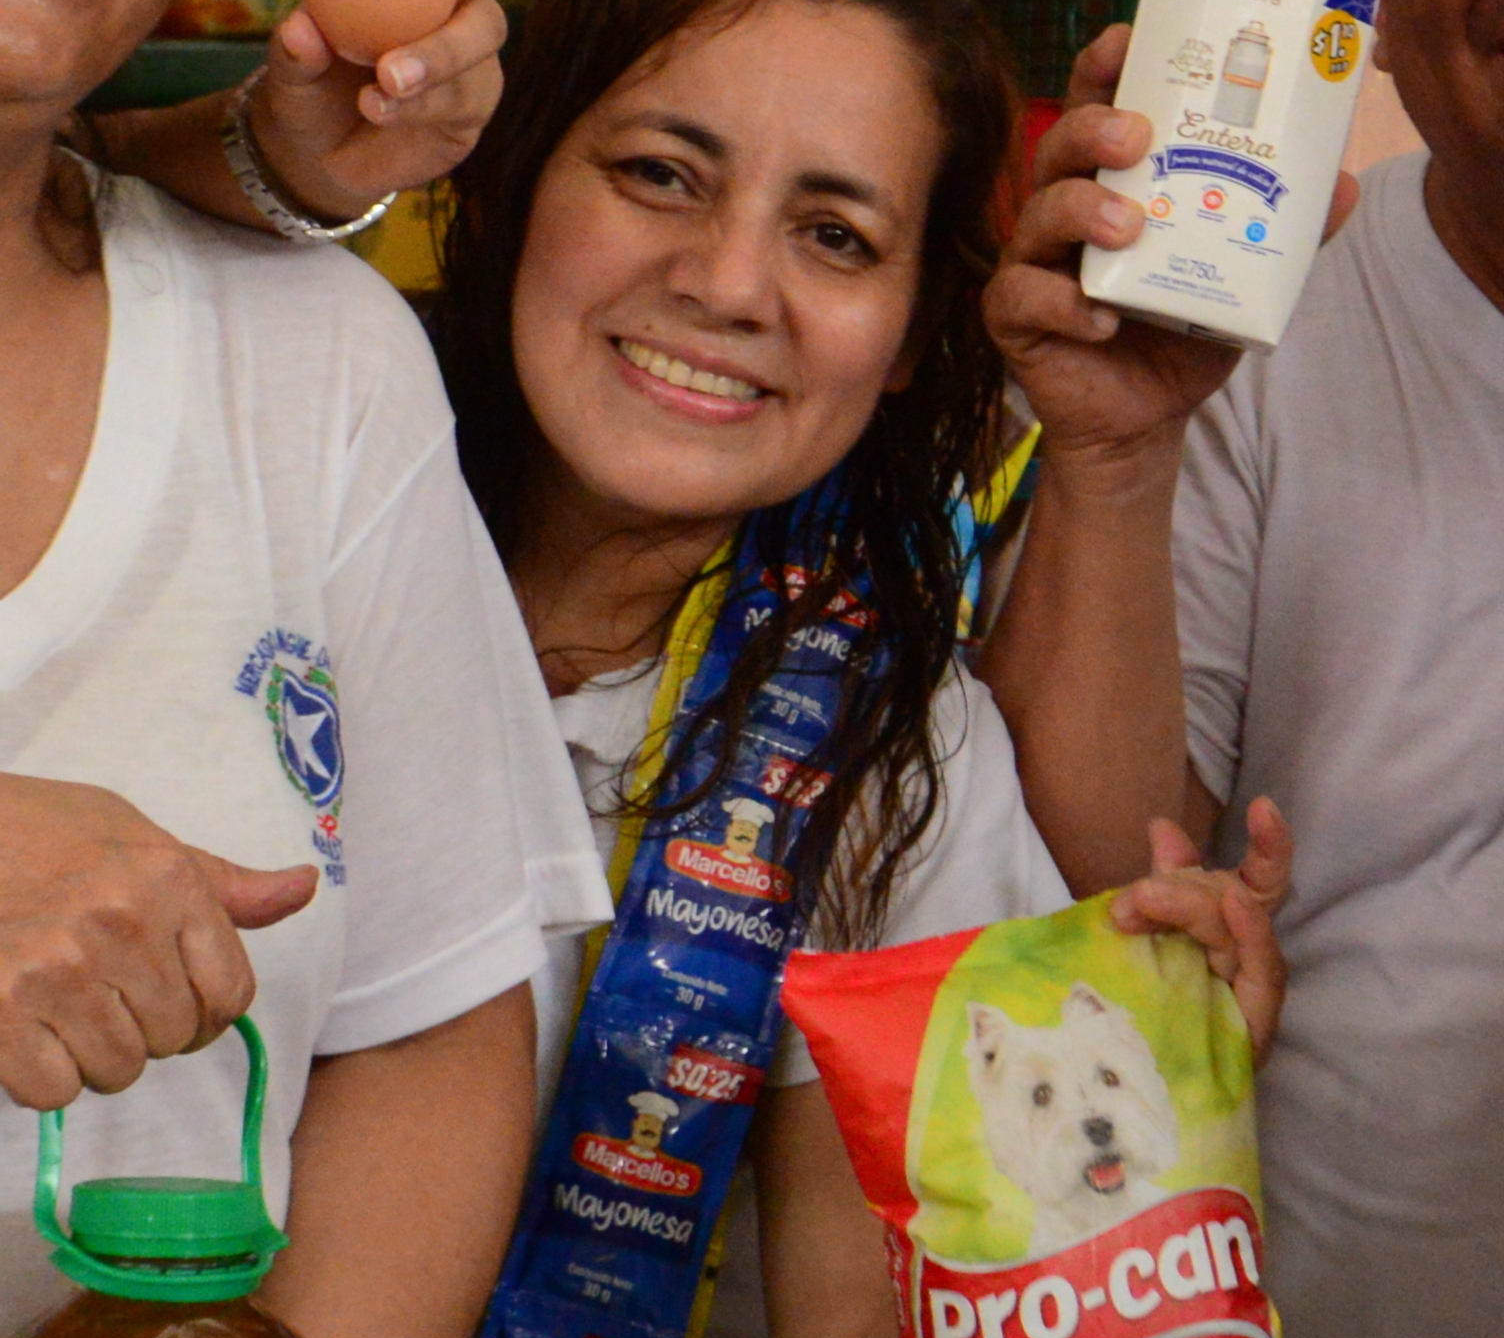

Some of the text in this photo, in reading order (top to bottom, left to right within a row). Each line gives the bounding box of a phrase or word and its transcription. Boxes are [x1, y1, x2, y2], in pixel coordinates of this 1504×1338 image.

[1176, 108, 1278, 160] Entera
[677, 845, 785, 896] Marcellos
[646, 888, 786, 952] Mayonesa
[675, 985, 695, 1004] 30
[582, 1139, 692, 1190] Marcello's
[554, 1182, 695, 1245] Mayonesa
